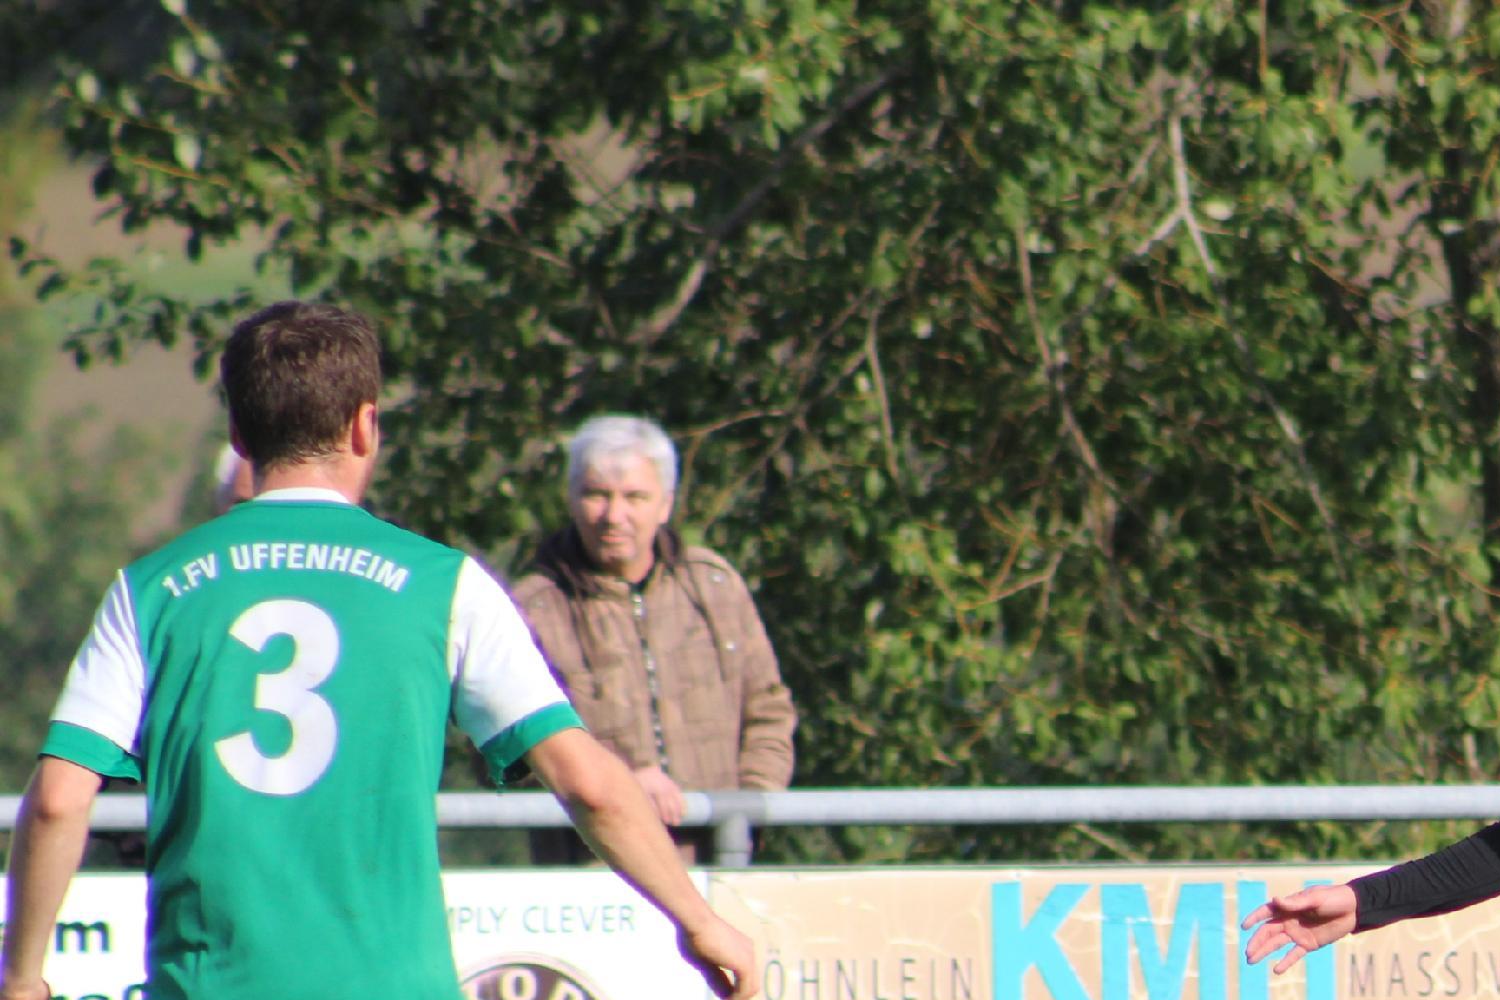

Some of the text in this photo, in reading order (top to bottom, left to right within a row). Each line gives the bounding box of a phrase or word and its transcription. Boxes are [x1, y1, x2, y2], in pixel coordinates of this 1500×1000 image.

[161, 543, 409, 597] 1.FV UFFENHEIM
[213, 599, 340, 796] 3
[522, 904, 636, 934] CLEVER
